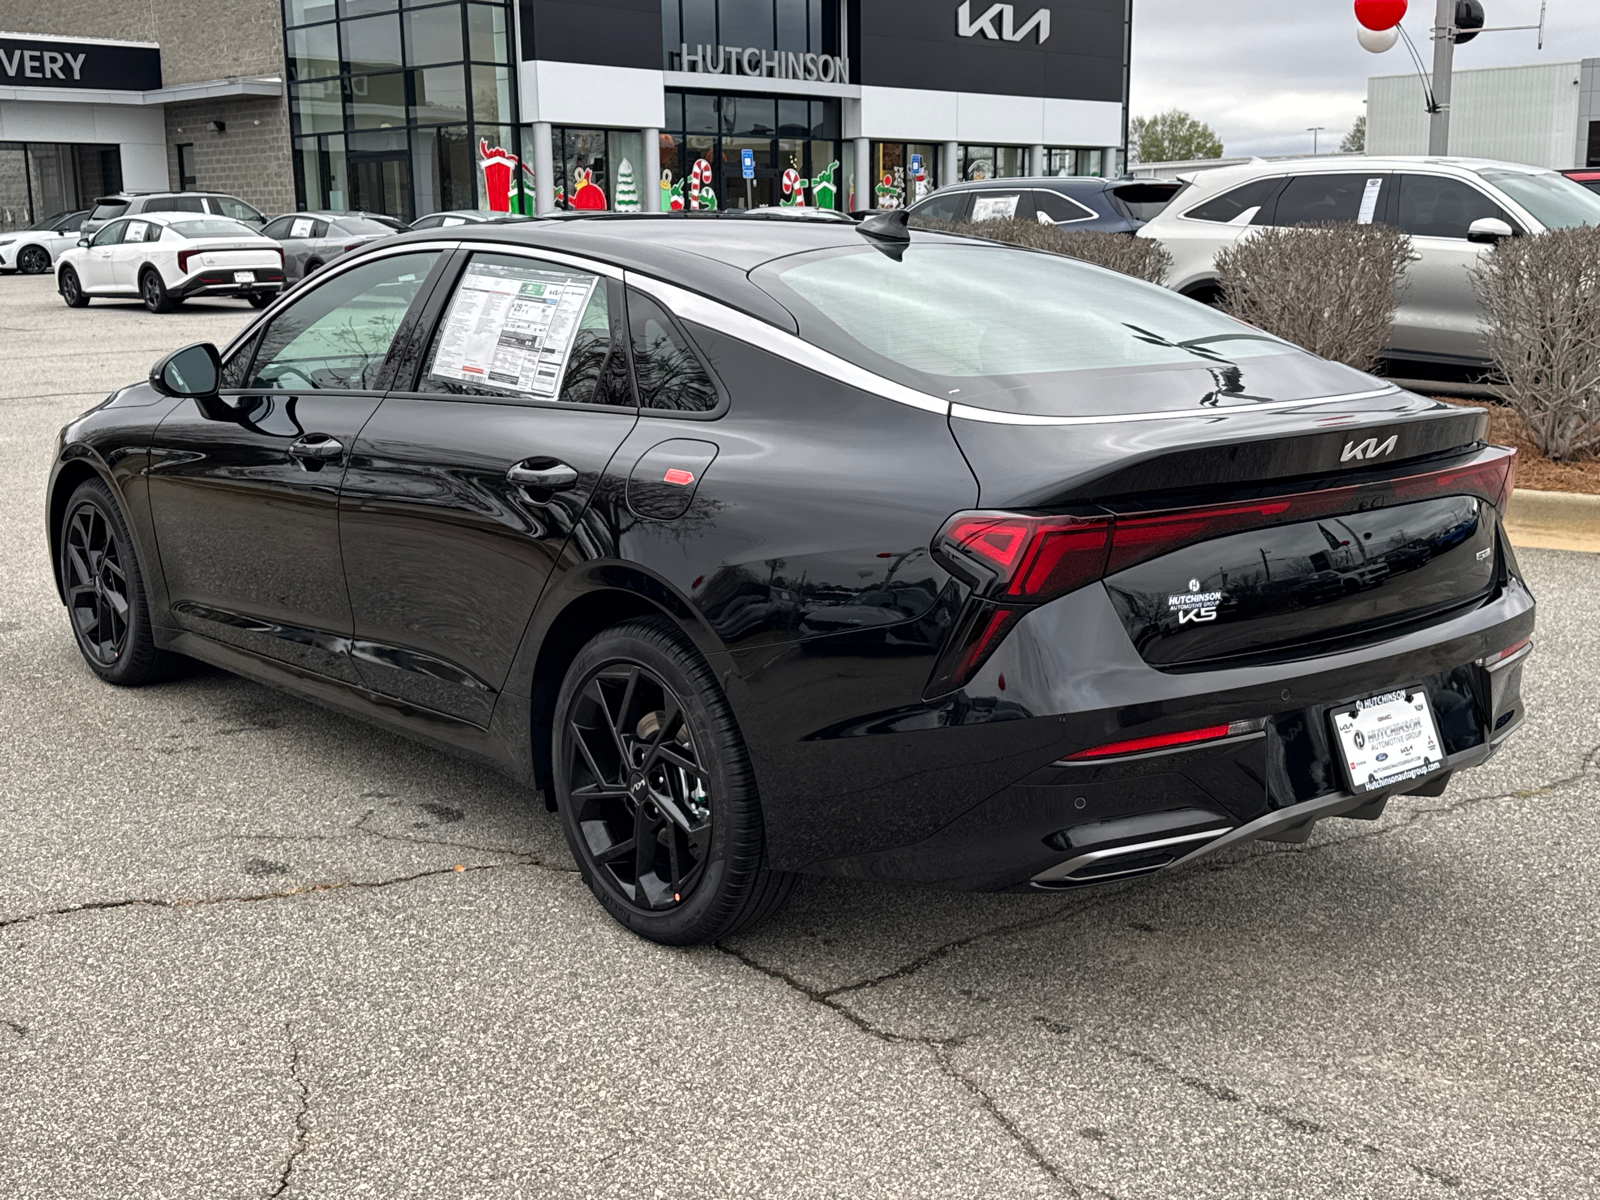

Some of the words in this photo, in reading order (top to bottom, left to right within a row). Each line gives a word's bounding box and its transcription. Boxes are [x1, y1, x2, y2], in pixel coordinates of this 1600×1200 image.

[0, 50, 87, 80] VERY
[680, 43, 850, 84] HUTCHINSON
[1339, 434, 1399, 462] KIA
[1168, 591, 1222, 605] HUTCHINSON
[1169, 603, 1203, 611] AUTOMOTIVE
[1178, 606, 1217, 624] K5
[1364, 689, 1406, 709] HUTCHINSON
[1377, 713, 1392, 722] GMC
[1366, 717, 1424, 744] HUTCHINSON
[1371, 735, 1404, 751] AUTOMOTIVE
[1405, 730, 1422, 742] GROUP
